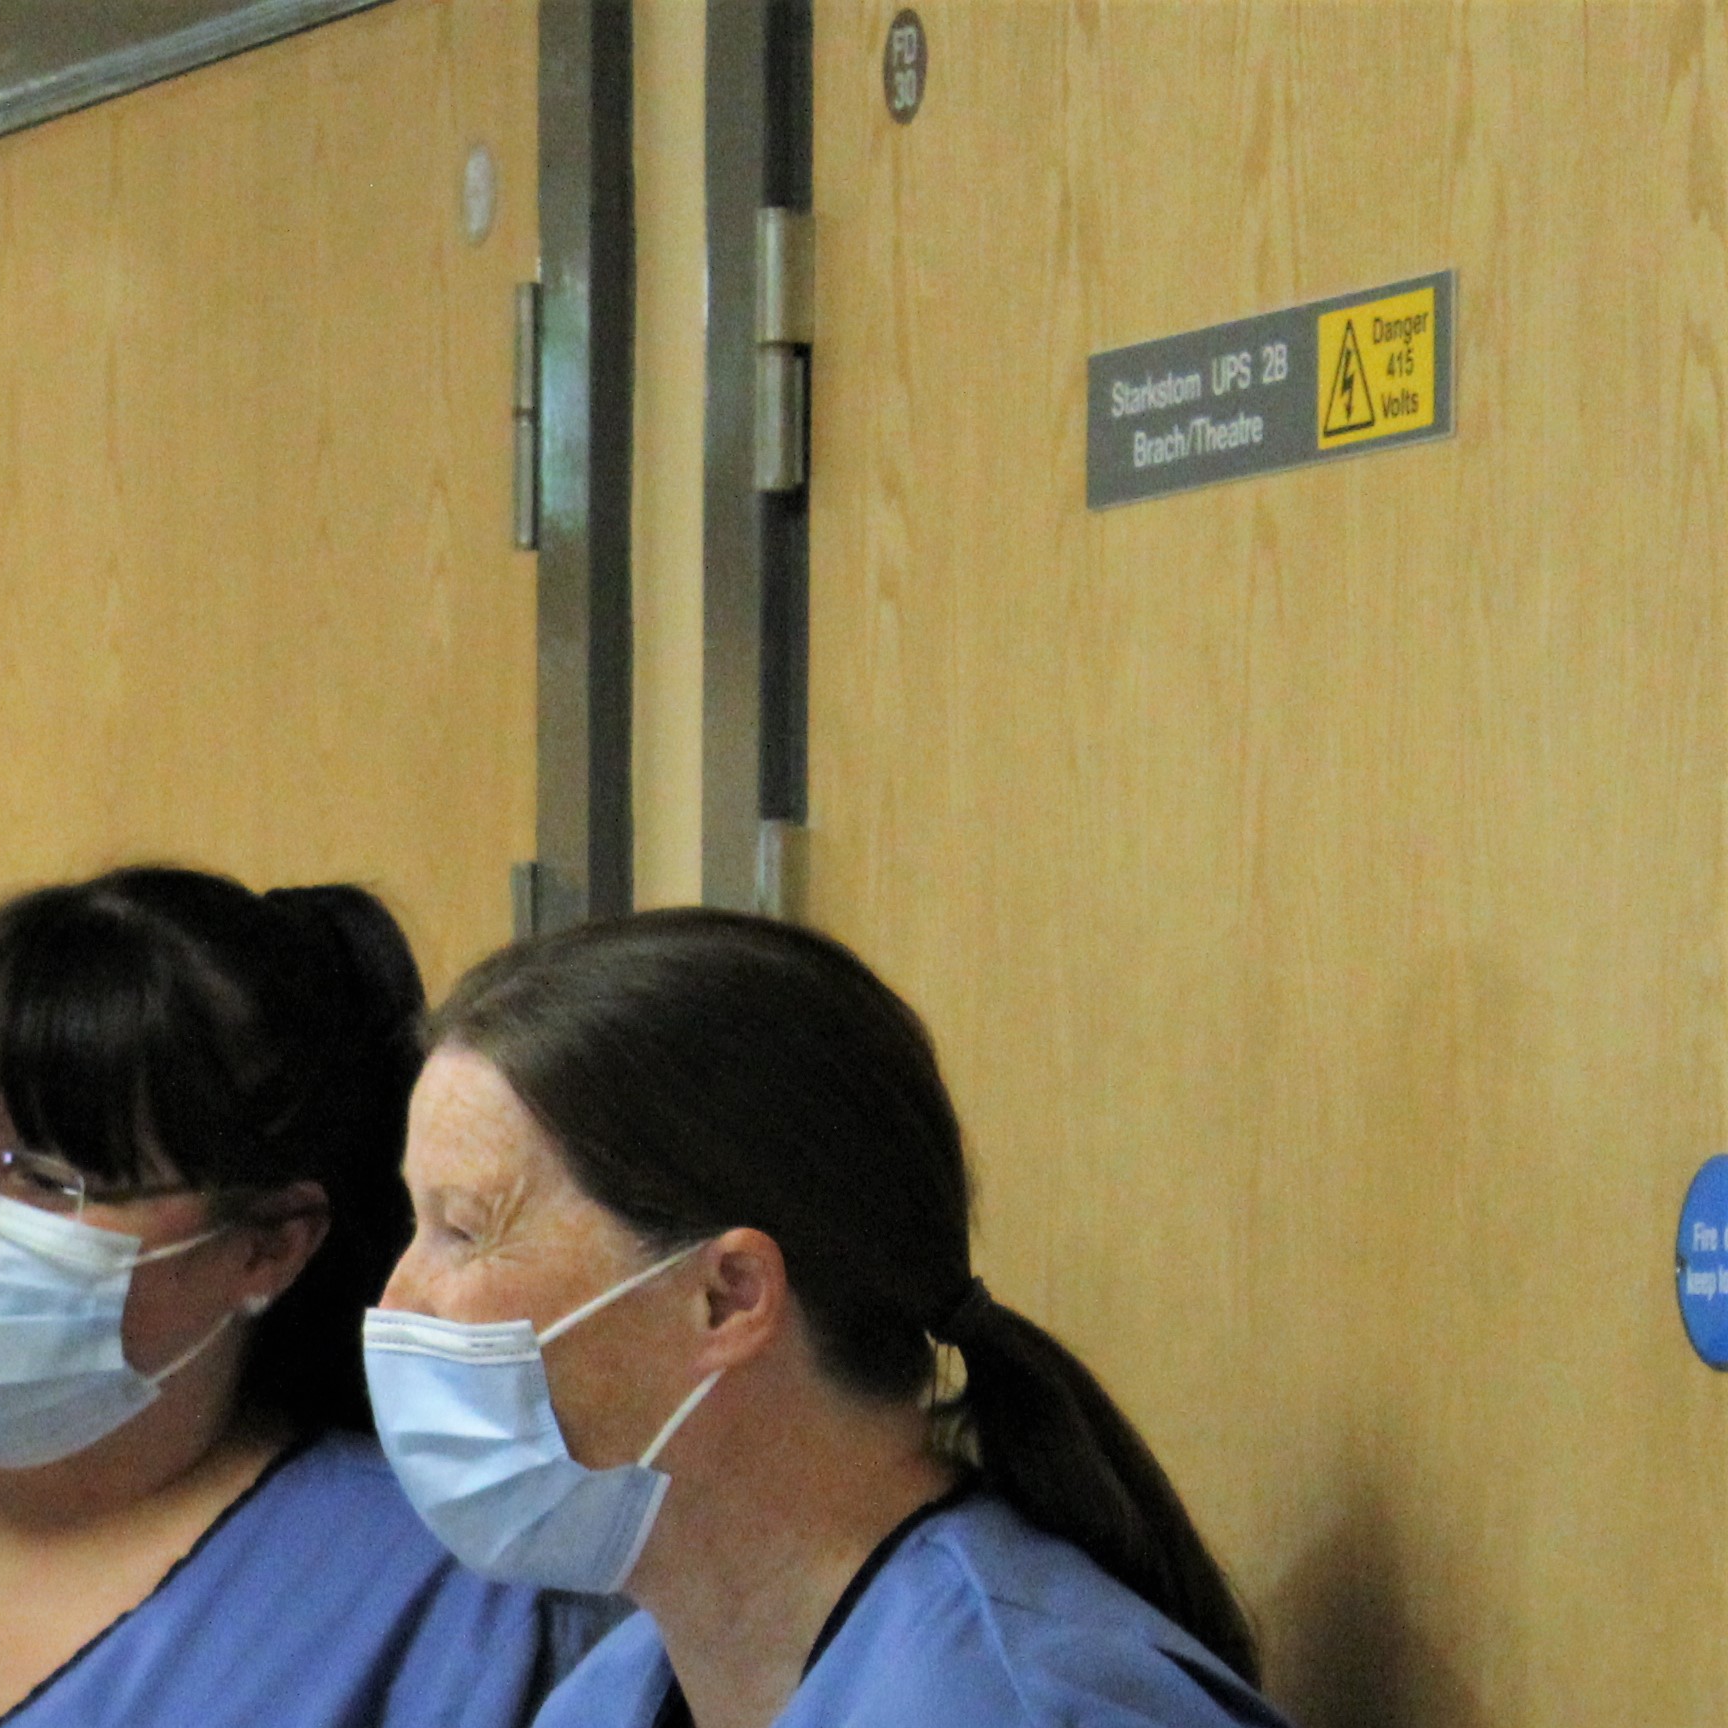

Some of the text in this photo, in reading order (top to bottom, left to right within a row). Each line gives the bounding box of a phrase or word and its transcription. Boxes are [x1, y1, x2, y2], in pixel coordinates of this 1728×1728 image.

[1373, 311, 1429, 345] Danger
[1111, 342, 1289, 417] Starkstom UPS 2B
[1386, 348, 1414, 377] 415
[1381, 387, 1419, 418] Volts
[1133, 410, 1264, 468] Brach/Theatre
